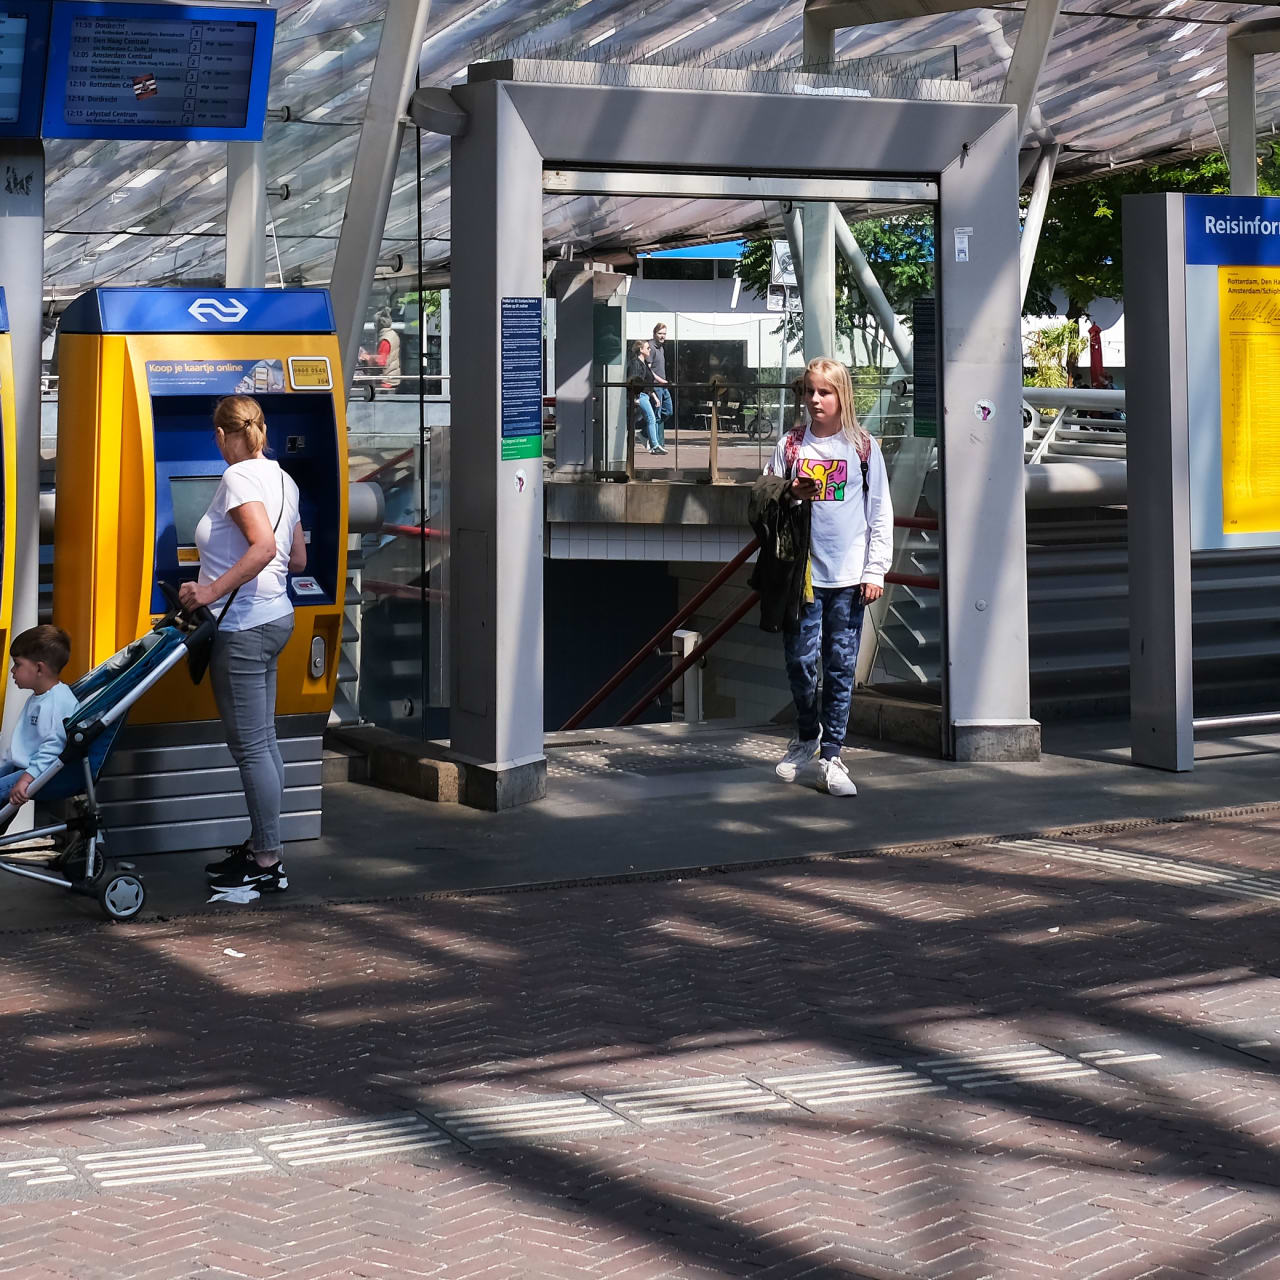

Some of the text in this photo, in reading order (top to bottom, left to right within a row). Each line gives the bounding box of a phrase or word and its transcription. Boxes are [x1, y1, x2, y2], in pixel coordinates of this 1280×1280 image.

[87, 111, 111, 119] Lelystad
[150, 364, 172, 373] Koop
[175, 364, 182, 373] je
[185, 364, 214, 373] kaartje
